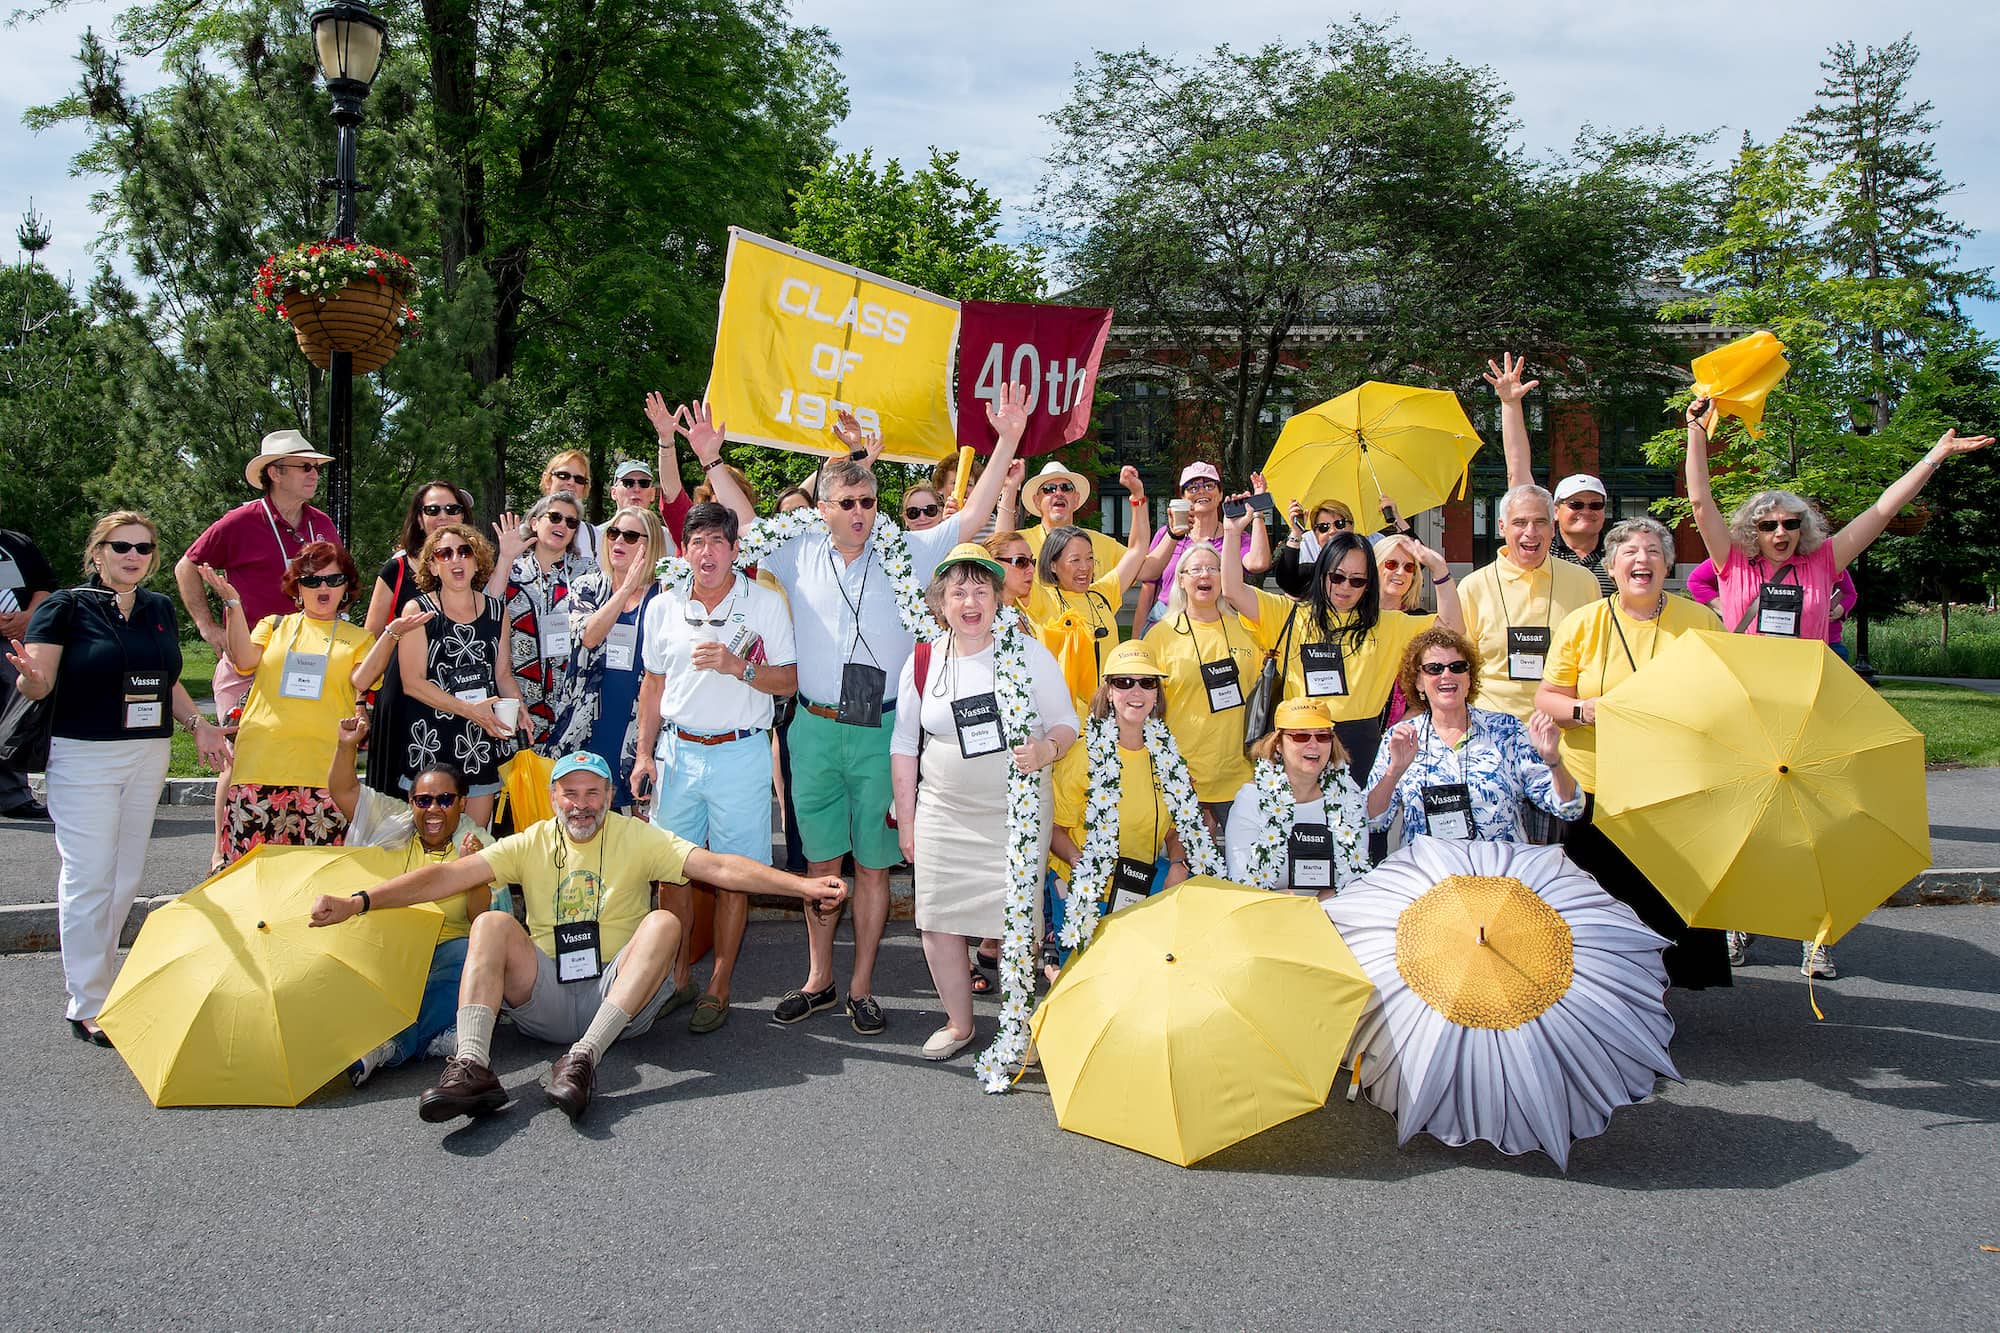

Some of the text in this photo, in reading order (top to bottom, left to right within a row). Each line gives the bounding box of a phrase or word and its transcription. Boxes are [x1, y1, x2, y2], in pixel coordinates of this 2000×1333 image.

[778, 278, 910, 345] CLASS
[810, 343, 863, 382] OF
[974, 342, 1087, 416] 40th
[1766, 586, 1796, 596] Vassar
[1514, 632, 1543, 642] Vassar
[1307, 648, 1336, 659] Vassar
[1207, 665, 1233, 676] Vassar
[130, 676, 161, 686] Vassar
[454, 673, 481, 684] Vassar
[959, 705, 991, 719] Vassar
[1430, 794, 1461, 805] Vassar
[1294, 831, 1326, 843] Vassar
[1122, 863, 1149, 882] Vassar
[561, 932, 592, 944] Vassar
